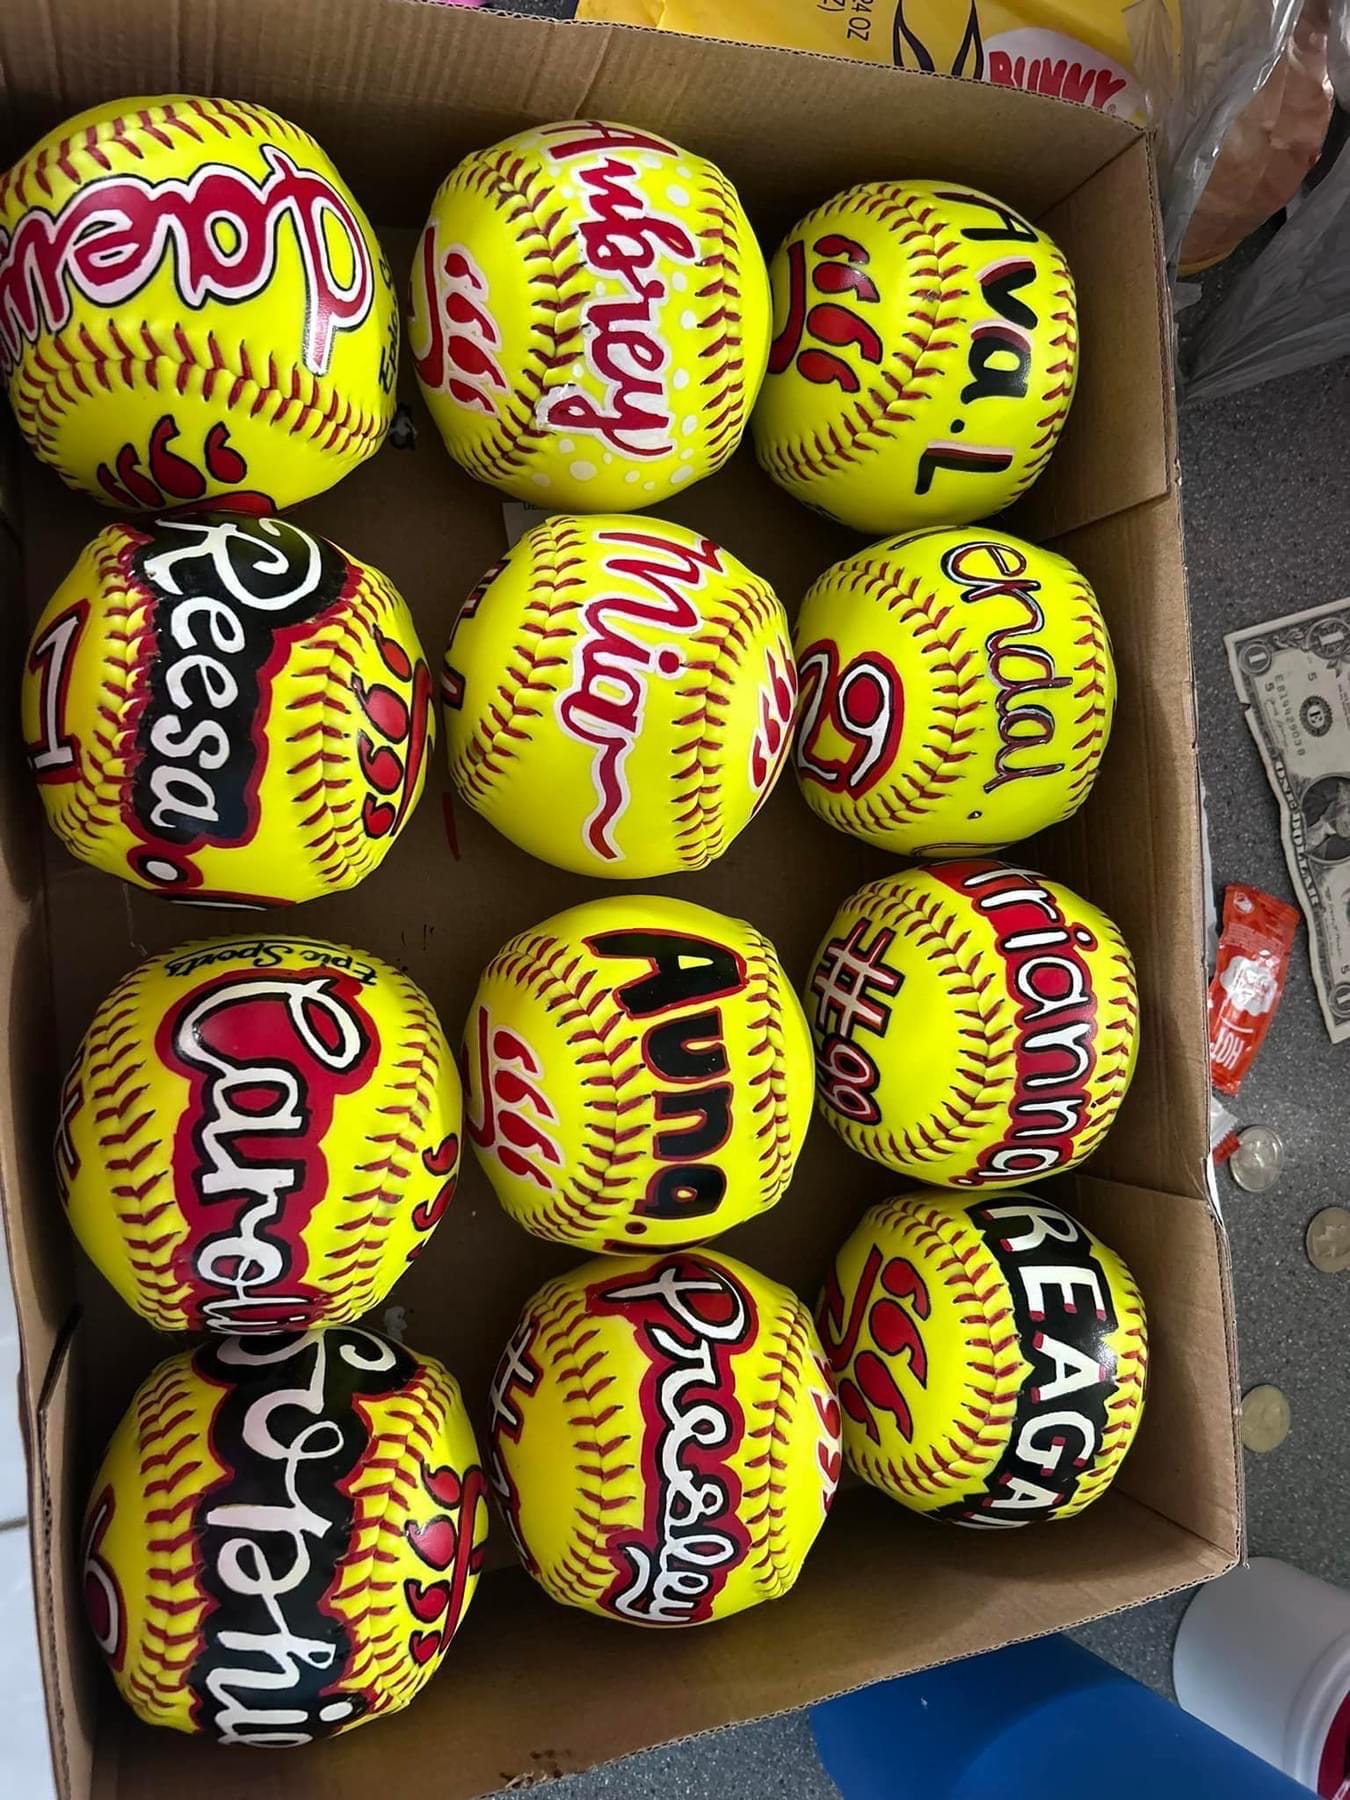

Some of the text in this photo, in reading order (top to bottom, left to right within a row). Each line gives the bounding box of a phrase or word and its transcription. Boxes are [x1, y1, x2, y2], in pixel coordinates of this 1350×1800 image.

[847, 16, 871, 41] OZ
[532, 119, 701, 461] Aubrey
[32, 612, 84, 777] 1
[1274, 759, 1299, 811] ONE
[1291, 811, 1320, 905] DOLLAR
[165, 943, 377, 986] Epic Sports
[602, 1264, 739, 1622] Presley
